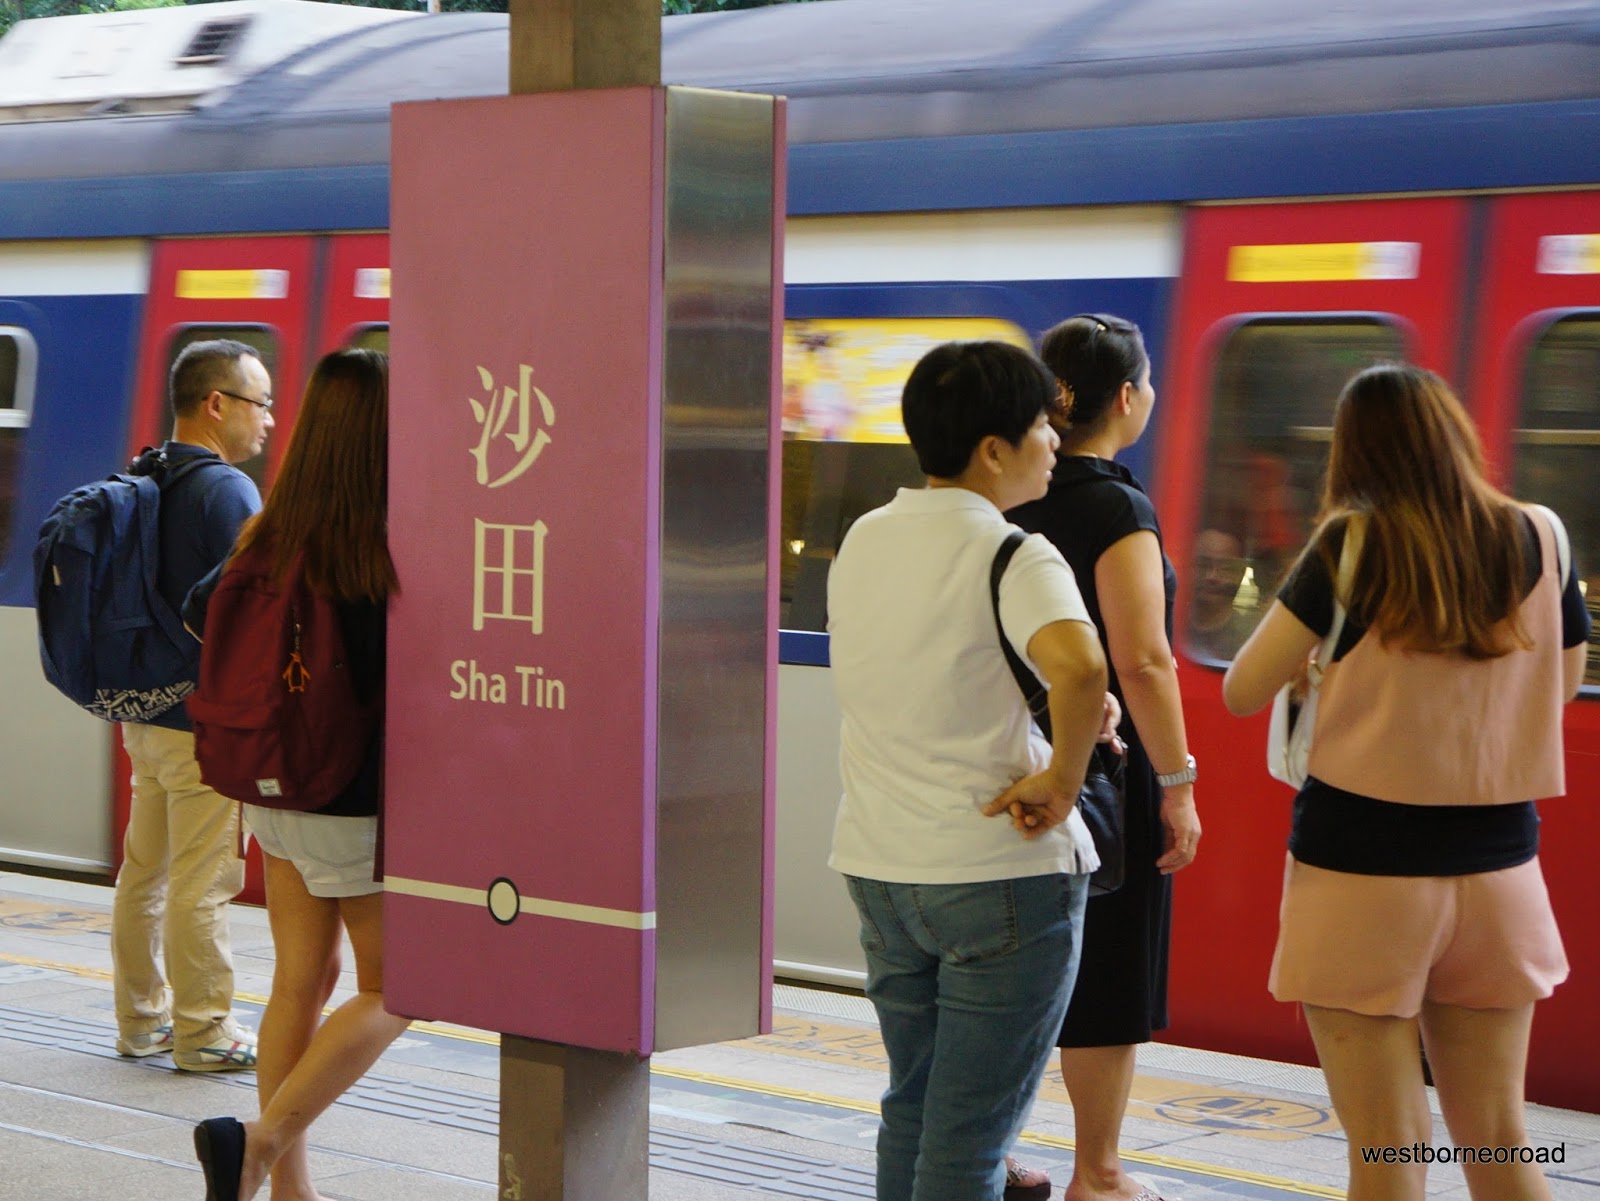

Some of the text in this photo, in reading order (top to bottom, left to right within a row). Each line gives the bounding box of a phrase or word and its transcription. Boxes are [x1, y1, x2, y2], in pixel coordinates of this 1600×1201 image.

[468, 363, 556, 635] 沙田
[450, 659, 566, 710] Sha Tin
